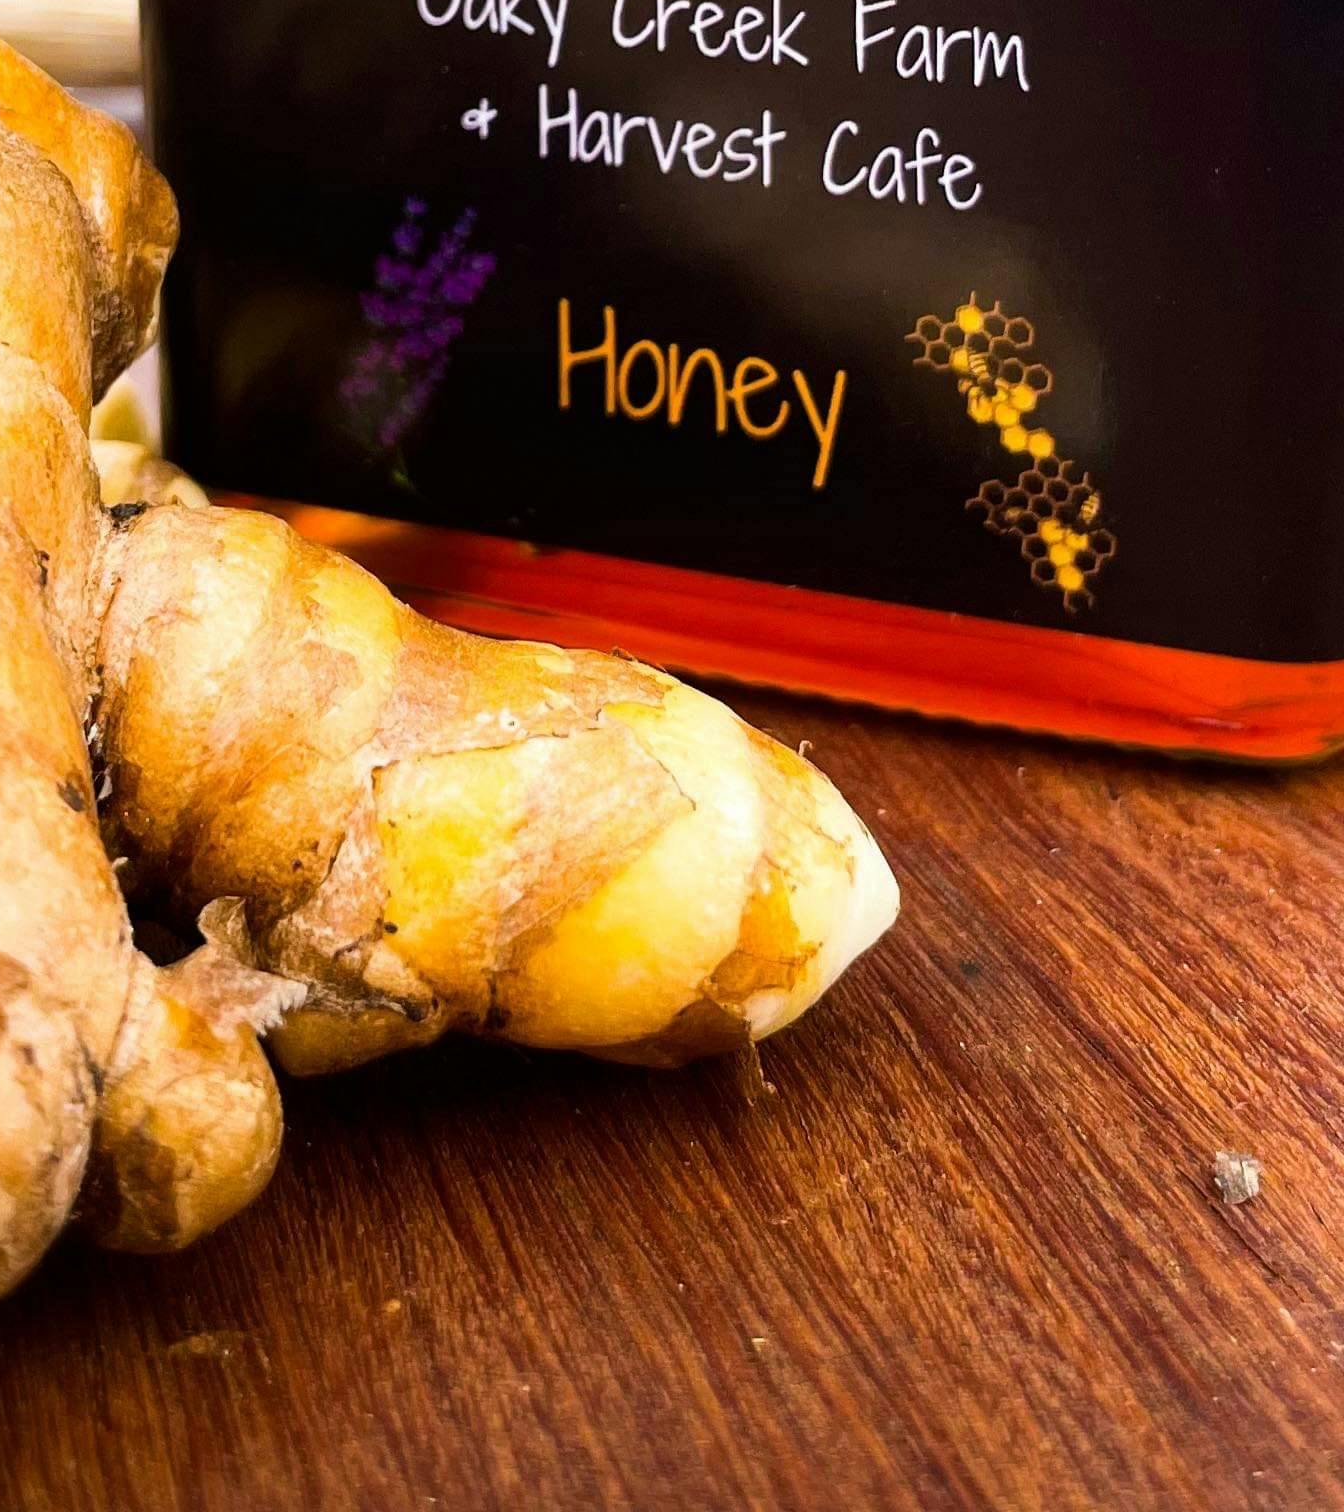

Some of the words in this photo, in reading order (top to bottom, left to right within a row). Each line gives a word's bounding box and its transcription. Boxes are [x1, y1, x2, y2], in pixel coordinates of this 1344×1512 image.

[539, 84, 786, 188] Harvest
[823, 121, 982, 210] Cafe
[560, 299, 845, 487] Honey
